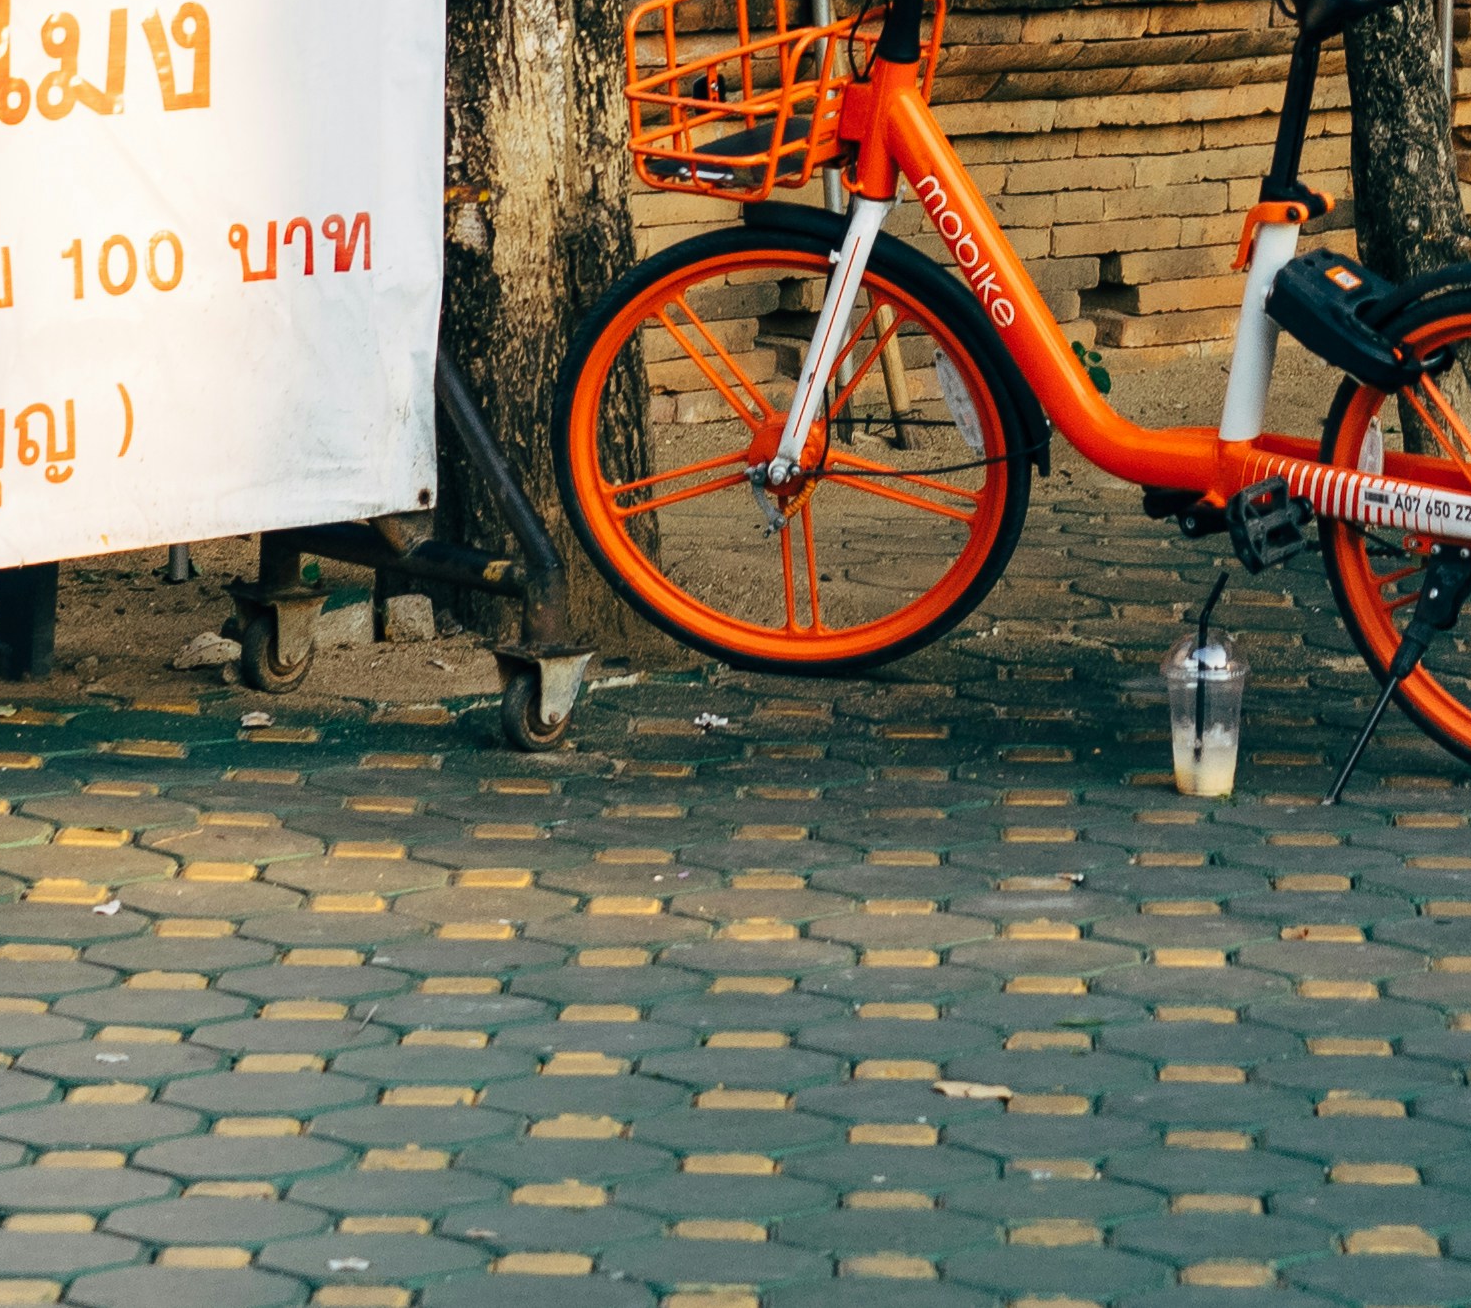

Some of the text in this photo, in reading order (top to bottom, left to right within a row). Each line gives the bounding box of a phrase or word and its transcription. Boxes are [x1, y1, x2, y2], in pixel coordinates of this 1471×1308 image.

[60, 229, 186, 302] 100
[227, 207, 373, 285] บาท
[915, 174, 1016, 329] mobike
[1394, 493, 1421, 513] A07
[1425, 497, 1450, 519] 650
